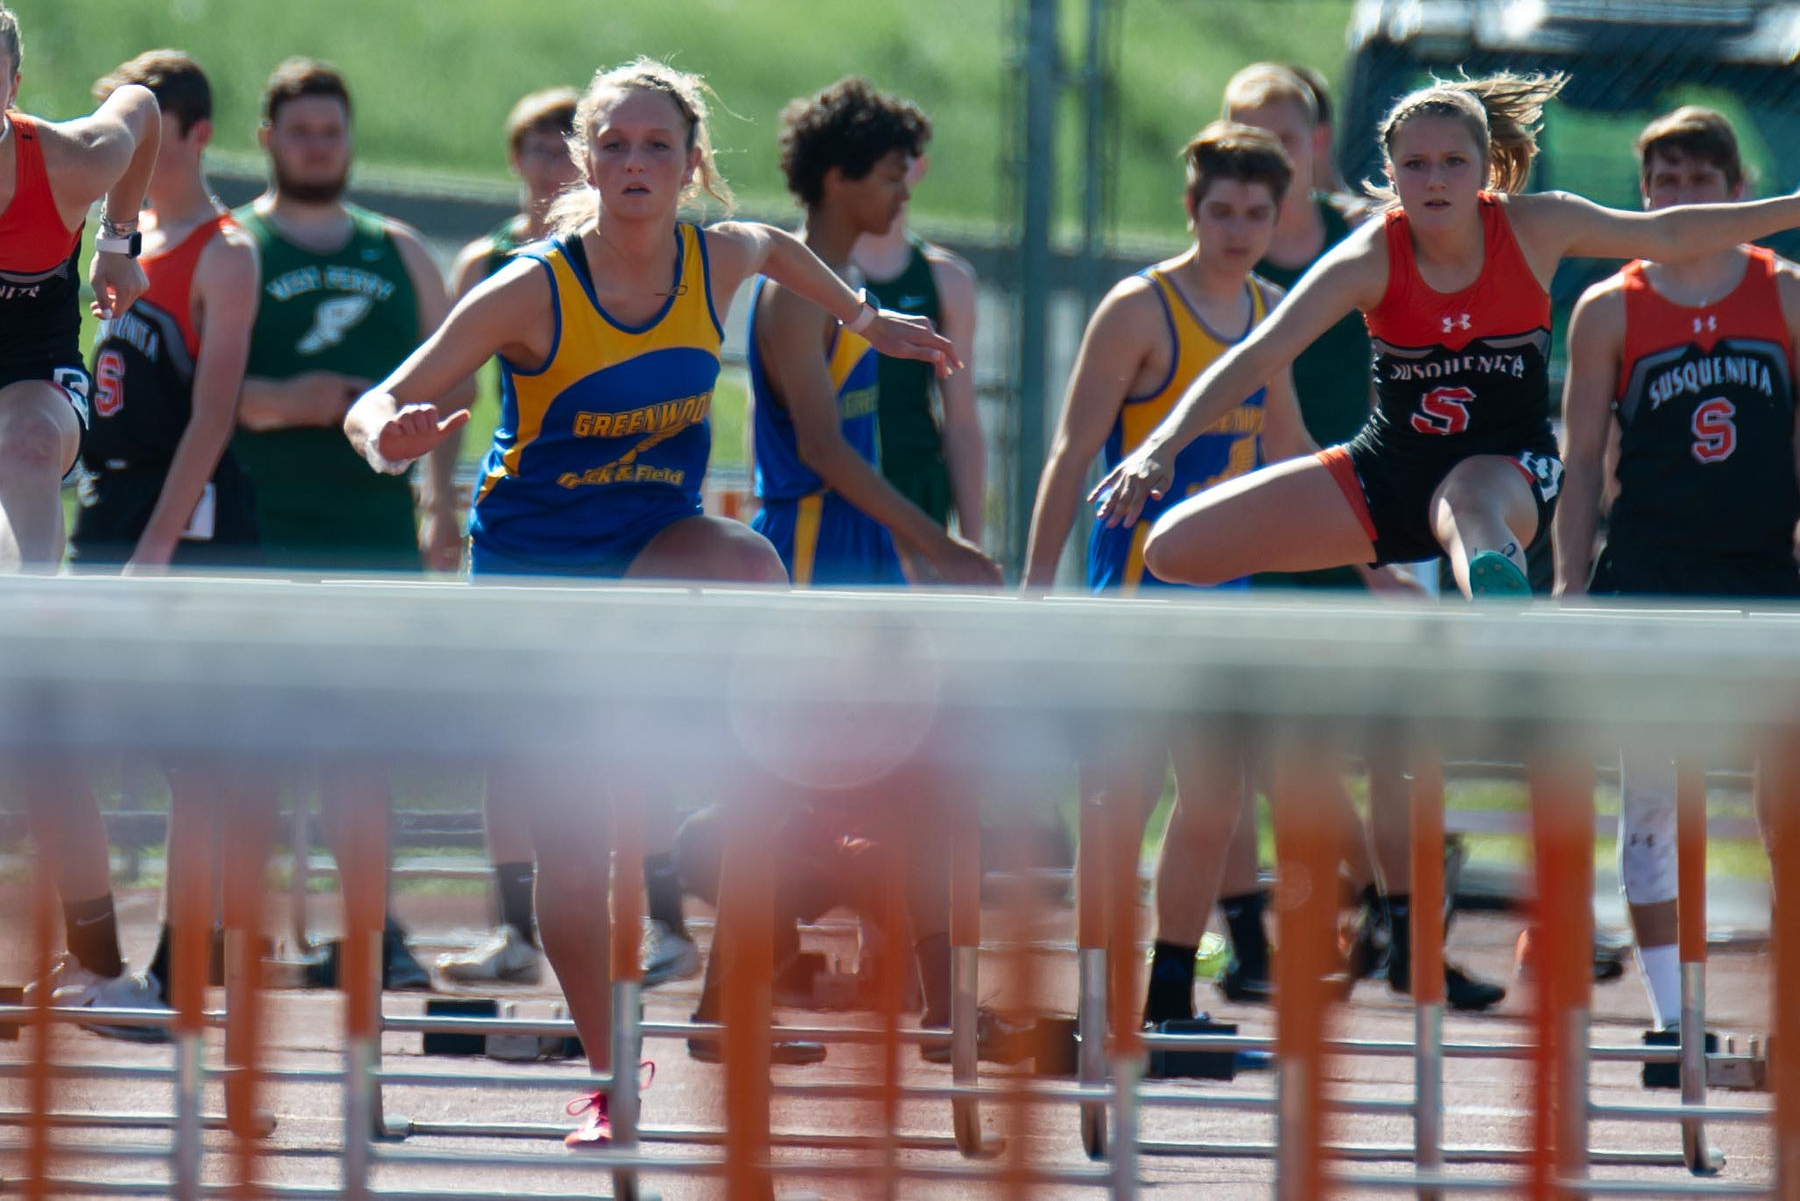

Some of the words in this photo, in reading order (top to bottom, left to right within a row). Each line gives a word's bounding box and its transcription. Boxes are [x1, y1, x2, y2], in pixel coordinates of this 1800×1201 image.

[94, 349, 126, 417] S
[1649, 356, 1773, 410] SUSQUENITA
[573, 390, 714, 438] GREENWOO
[1410, 385, 1477, 436] S
[1690, 396, 1737, 464] S
[634, 464, 686, 487] Field
